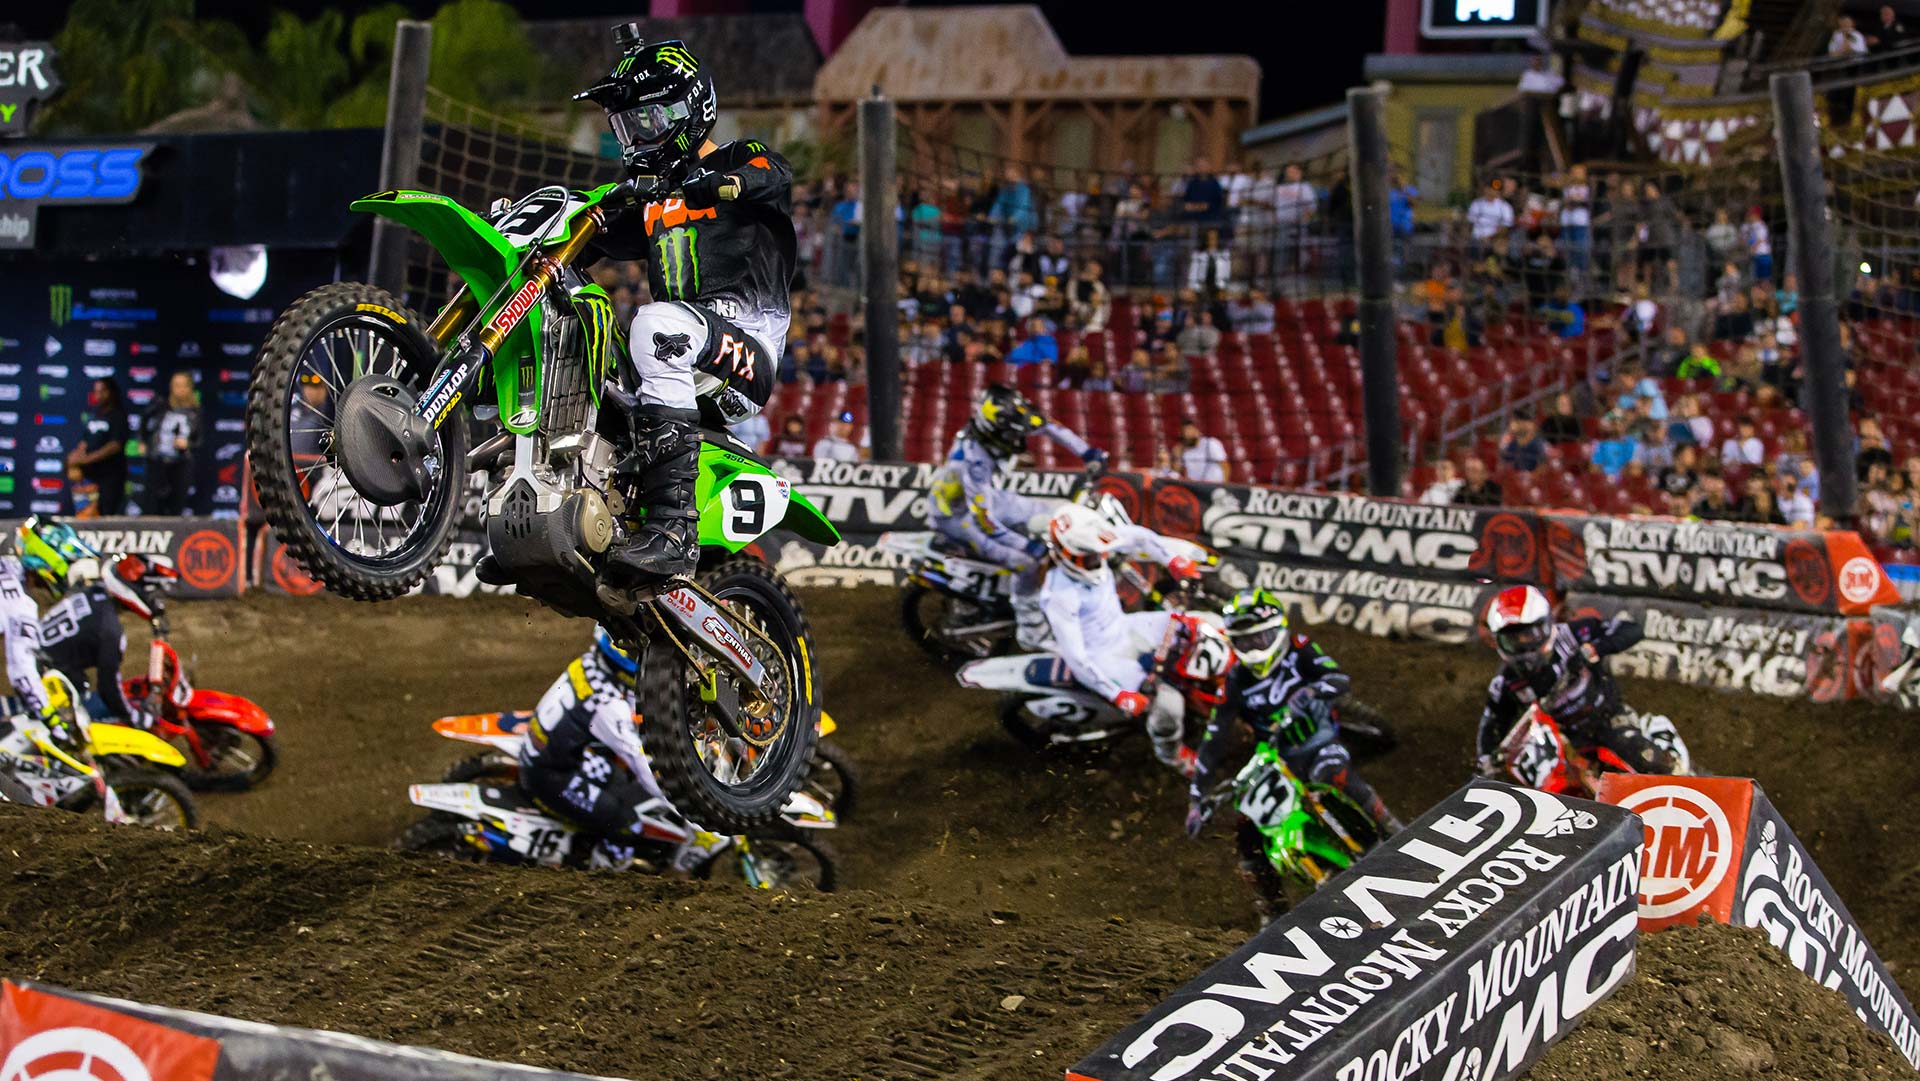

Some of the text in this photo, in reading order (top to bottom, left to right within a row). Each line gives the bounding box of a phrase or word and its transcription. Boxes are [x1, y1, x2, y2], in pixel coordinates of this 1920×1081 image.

[633, 69, 650, 84] FOX
[687, 79, 704, 104] FOX
[500, 279, 542, 336] SHOWA
[423, 363, 469, 424] DUNLOP
[723, 453, 745, 464] 450
[810, 458, 909, 488] ROCKY
[728, 480, 765, 534] 9
[1245, 487, 1477, 533] ROCKY MOUNTAIN
[79, 530, 174, 553] NTAIN
[1253, 562, 1481, 607] ROCKY MOUNTAIN
[703, 617, 753, 665] RENTHAL
[1417, 838, 1565, 938] ROCKY
[1782, 843, 1844, 952] ROCKY
[1460, 844, 1643, 1034] MOUNTAIN
